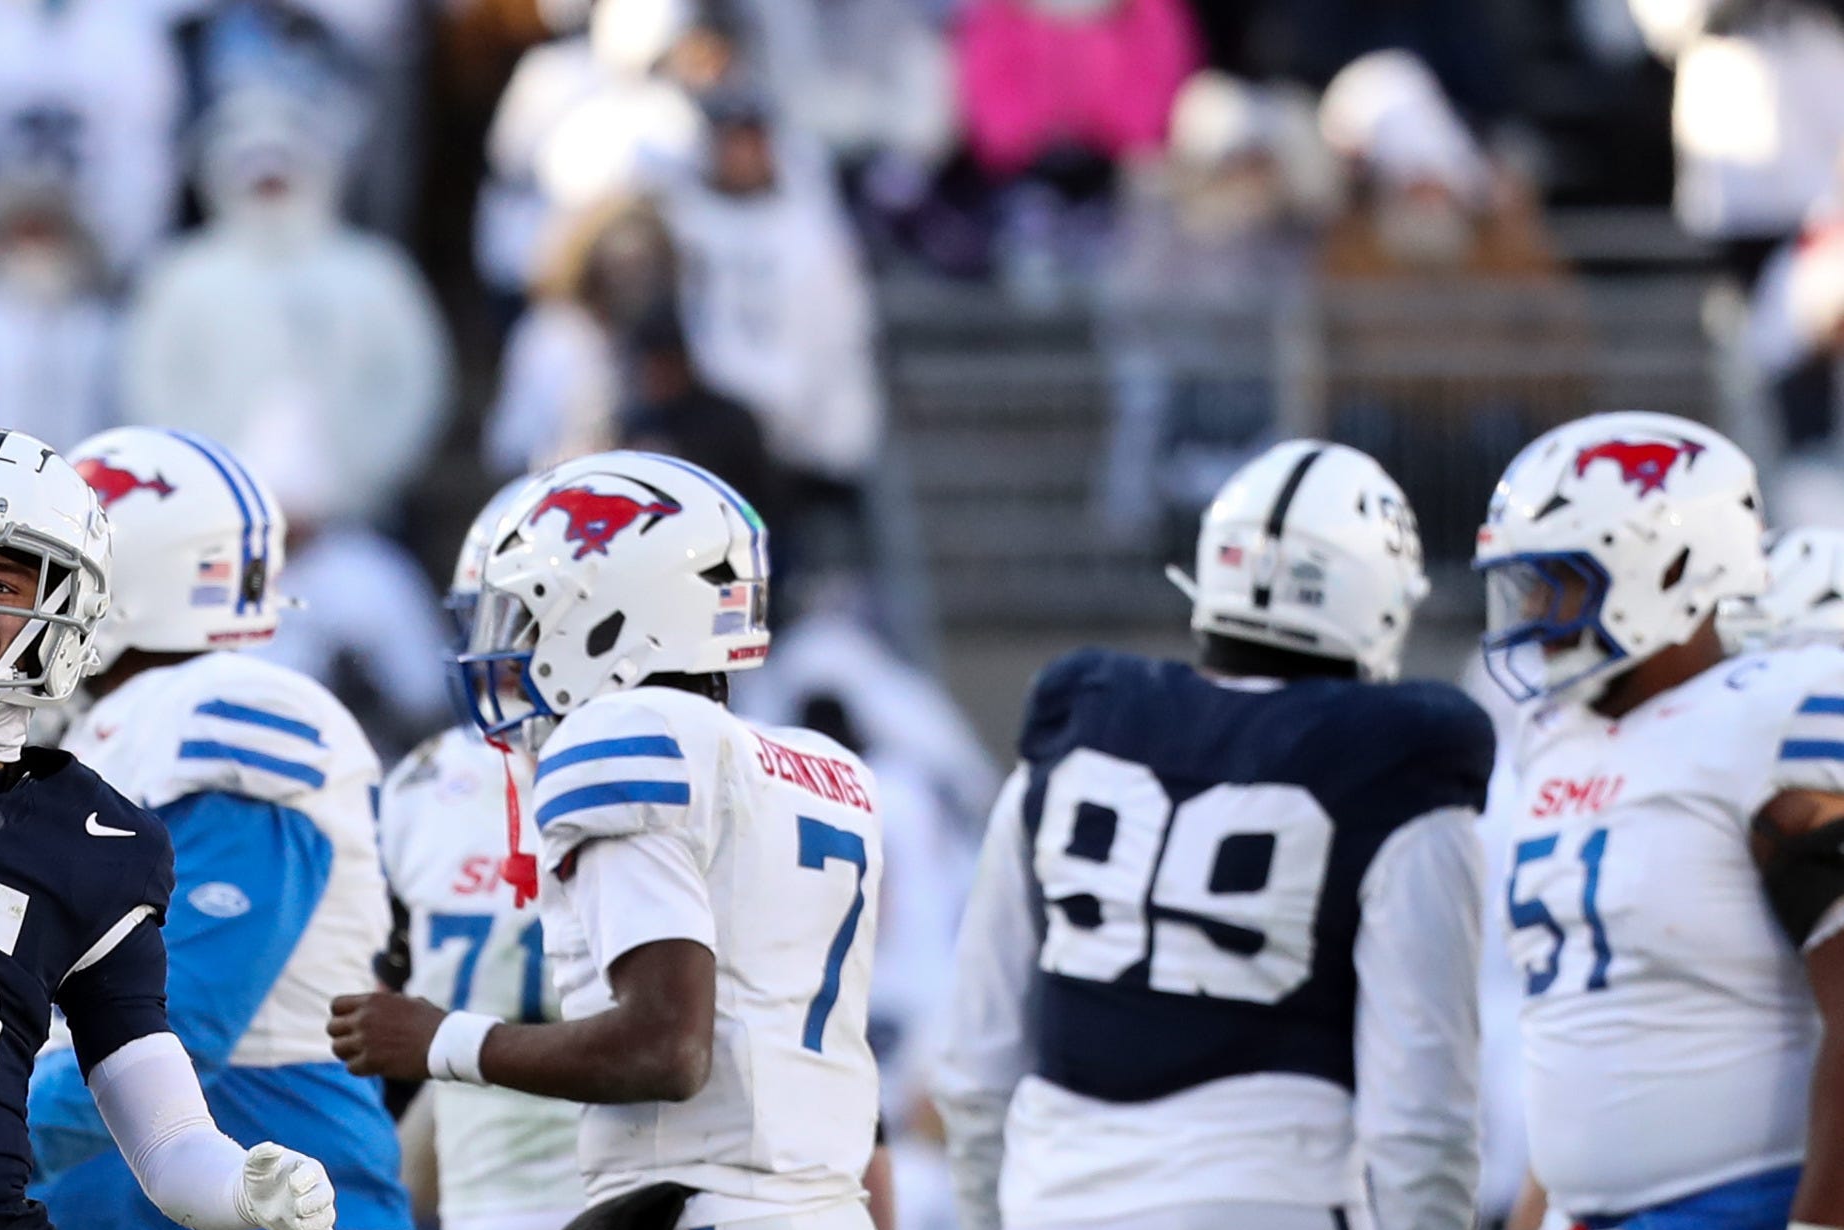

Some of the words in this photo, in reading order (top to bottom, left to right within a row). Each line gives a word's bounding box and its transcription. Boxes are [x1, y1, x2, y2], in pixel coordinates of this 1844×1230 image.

[795, 814, 868, 1054] 7
[1034, 747, 1336, 1005] 99
[1507, 829, 1613, 995] 51
